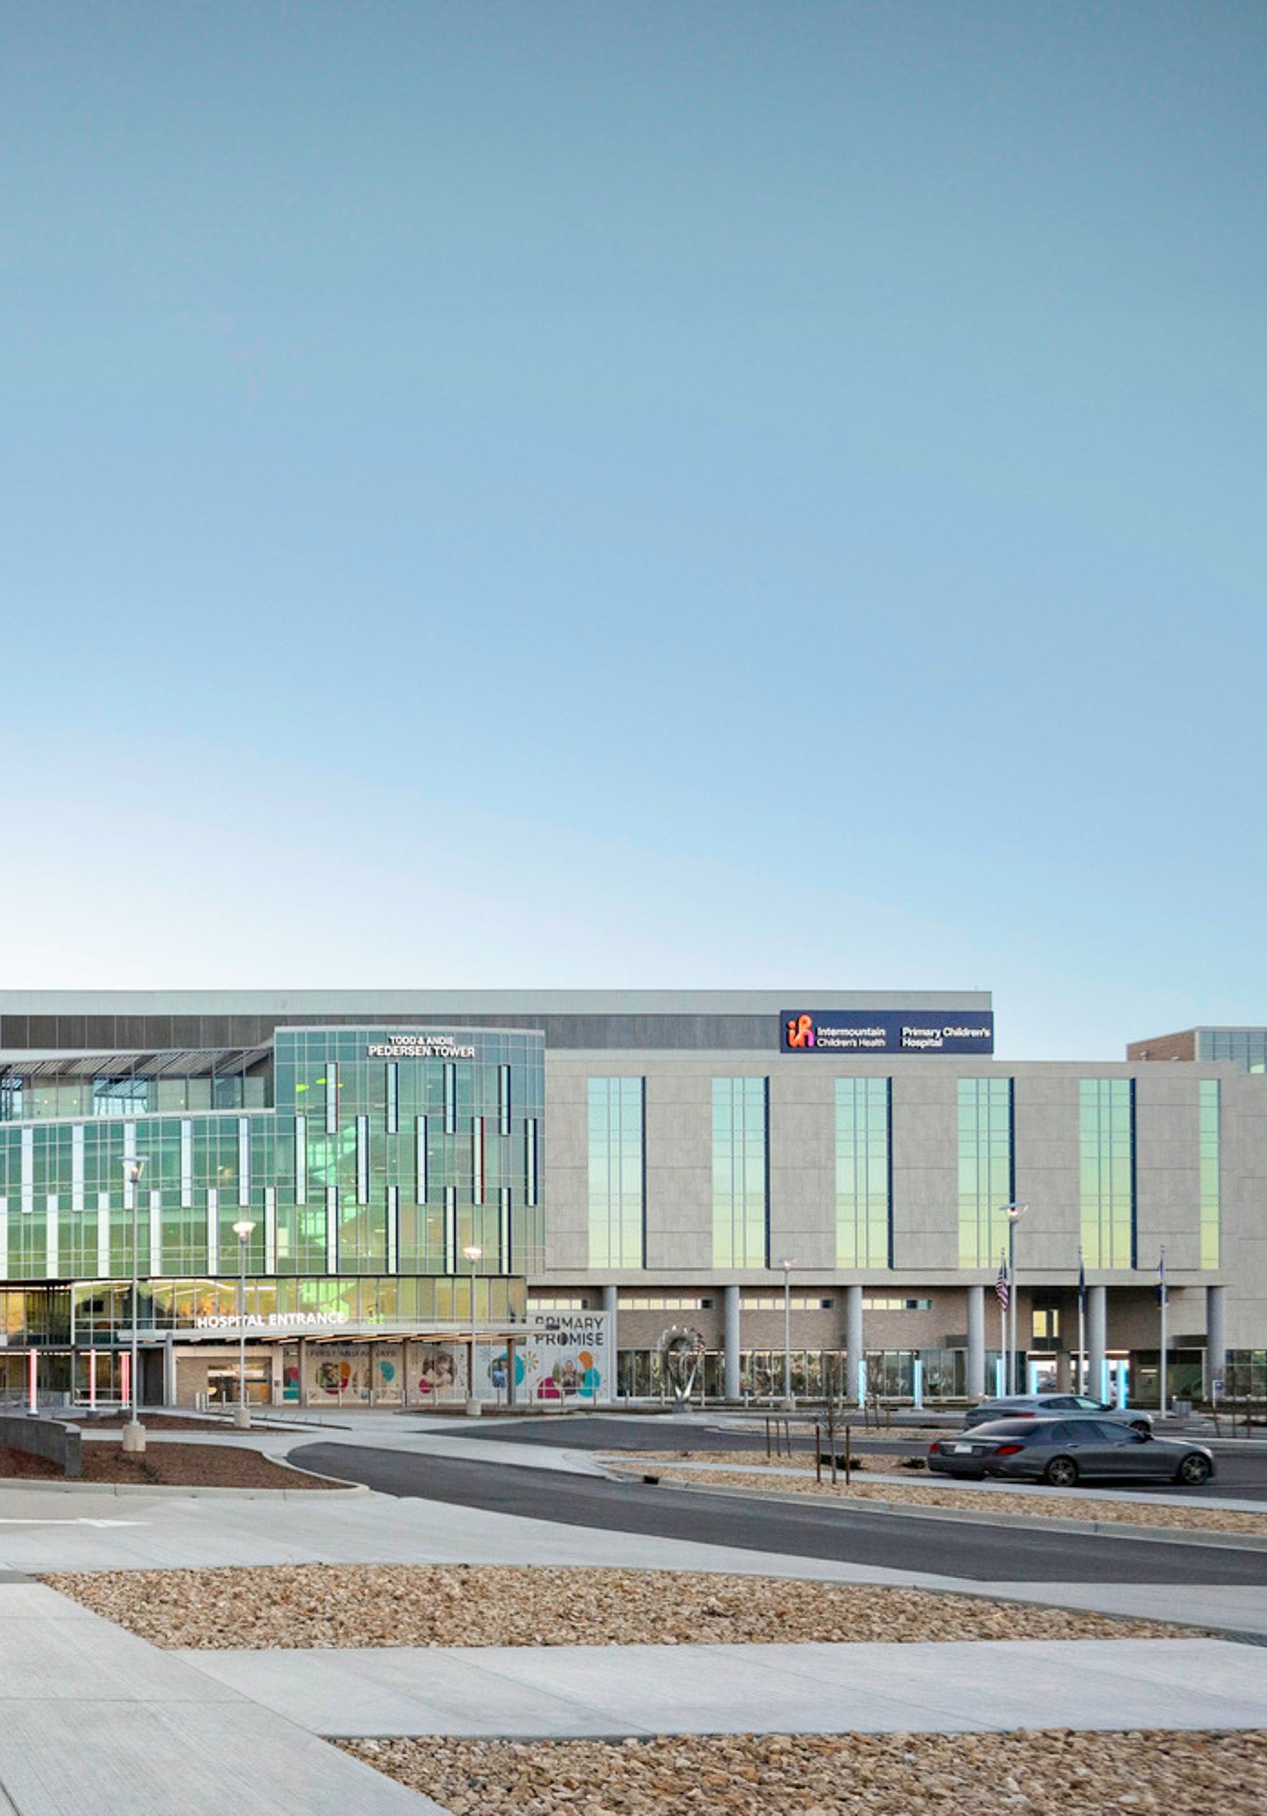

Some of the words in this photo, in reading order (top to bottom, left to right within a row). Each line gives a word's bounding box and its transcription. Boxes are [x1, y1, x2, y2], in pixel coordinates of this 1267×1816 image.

[817, 1027, 886, 1036] Intermountain
[902, 1027, 941, 1038] Primary
[943, 1028, 991, 1037] Children's
[817, 1038, 857, 1047] Children's
[858, 1038, 886, 1047] Health
[902, 1038, 943, 1048] Hospital
[369, 1045, 432, 1056] PEDERSEN
[434, 1046, 475, 1058] TOWER
[197, 1313, 265, 1328] HOSPITAL
[268, 1311, 346, 1325] ENTRANCE
[535, 1316, 604, 1330] PRIMARY
[534, 1332, 604, 1346] PROMISE
